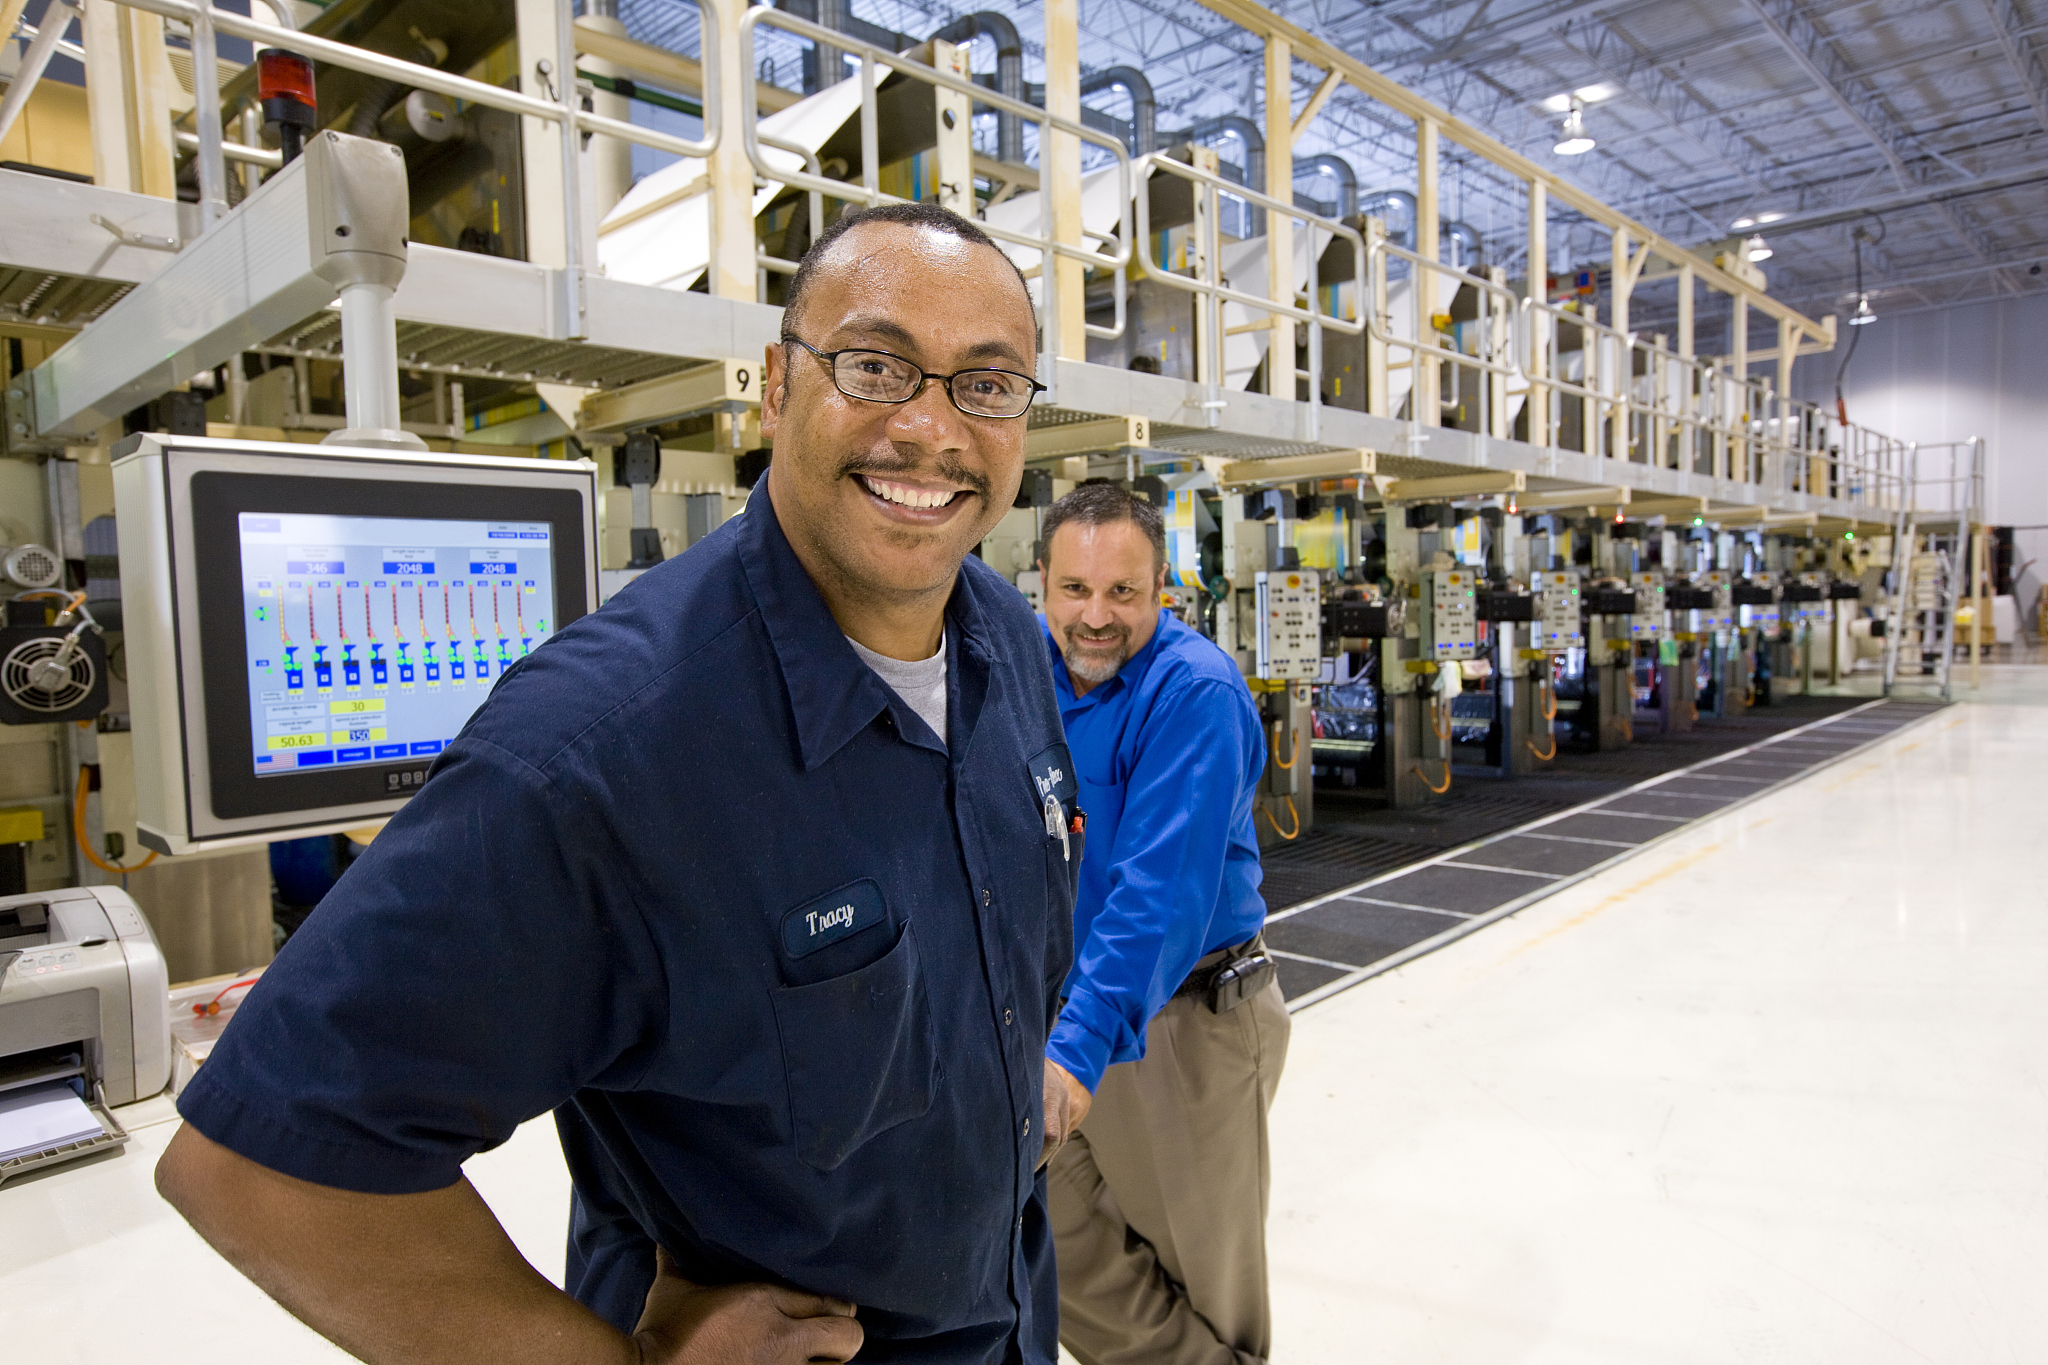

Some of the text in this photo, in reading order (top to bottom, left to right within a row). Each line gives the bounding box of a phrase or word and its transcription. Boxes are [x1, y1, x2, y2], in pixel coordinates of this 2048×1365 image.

[737, 368, 750, 392] 9
[1135, 422, 1144, 440] 8
[306, 563, 328, 574] 346
[396, 563, 423, 574] 2048
[482, 563, 506, 574] 2048
[352, 701, 365, 712] 30
[280, 735, 313, 748] 50.63
[350, 731, 369, 742] 350
[805, 904, 854, 936] Tracy
